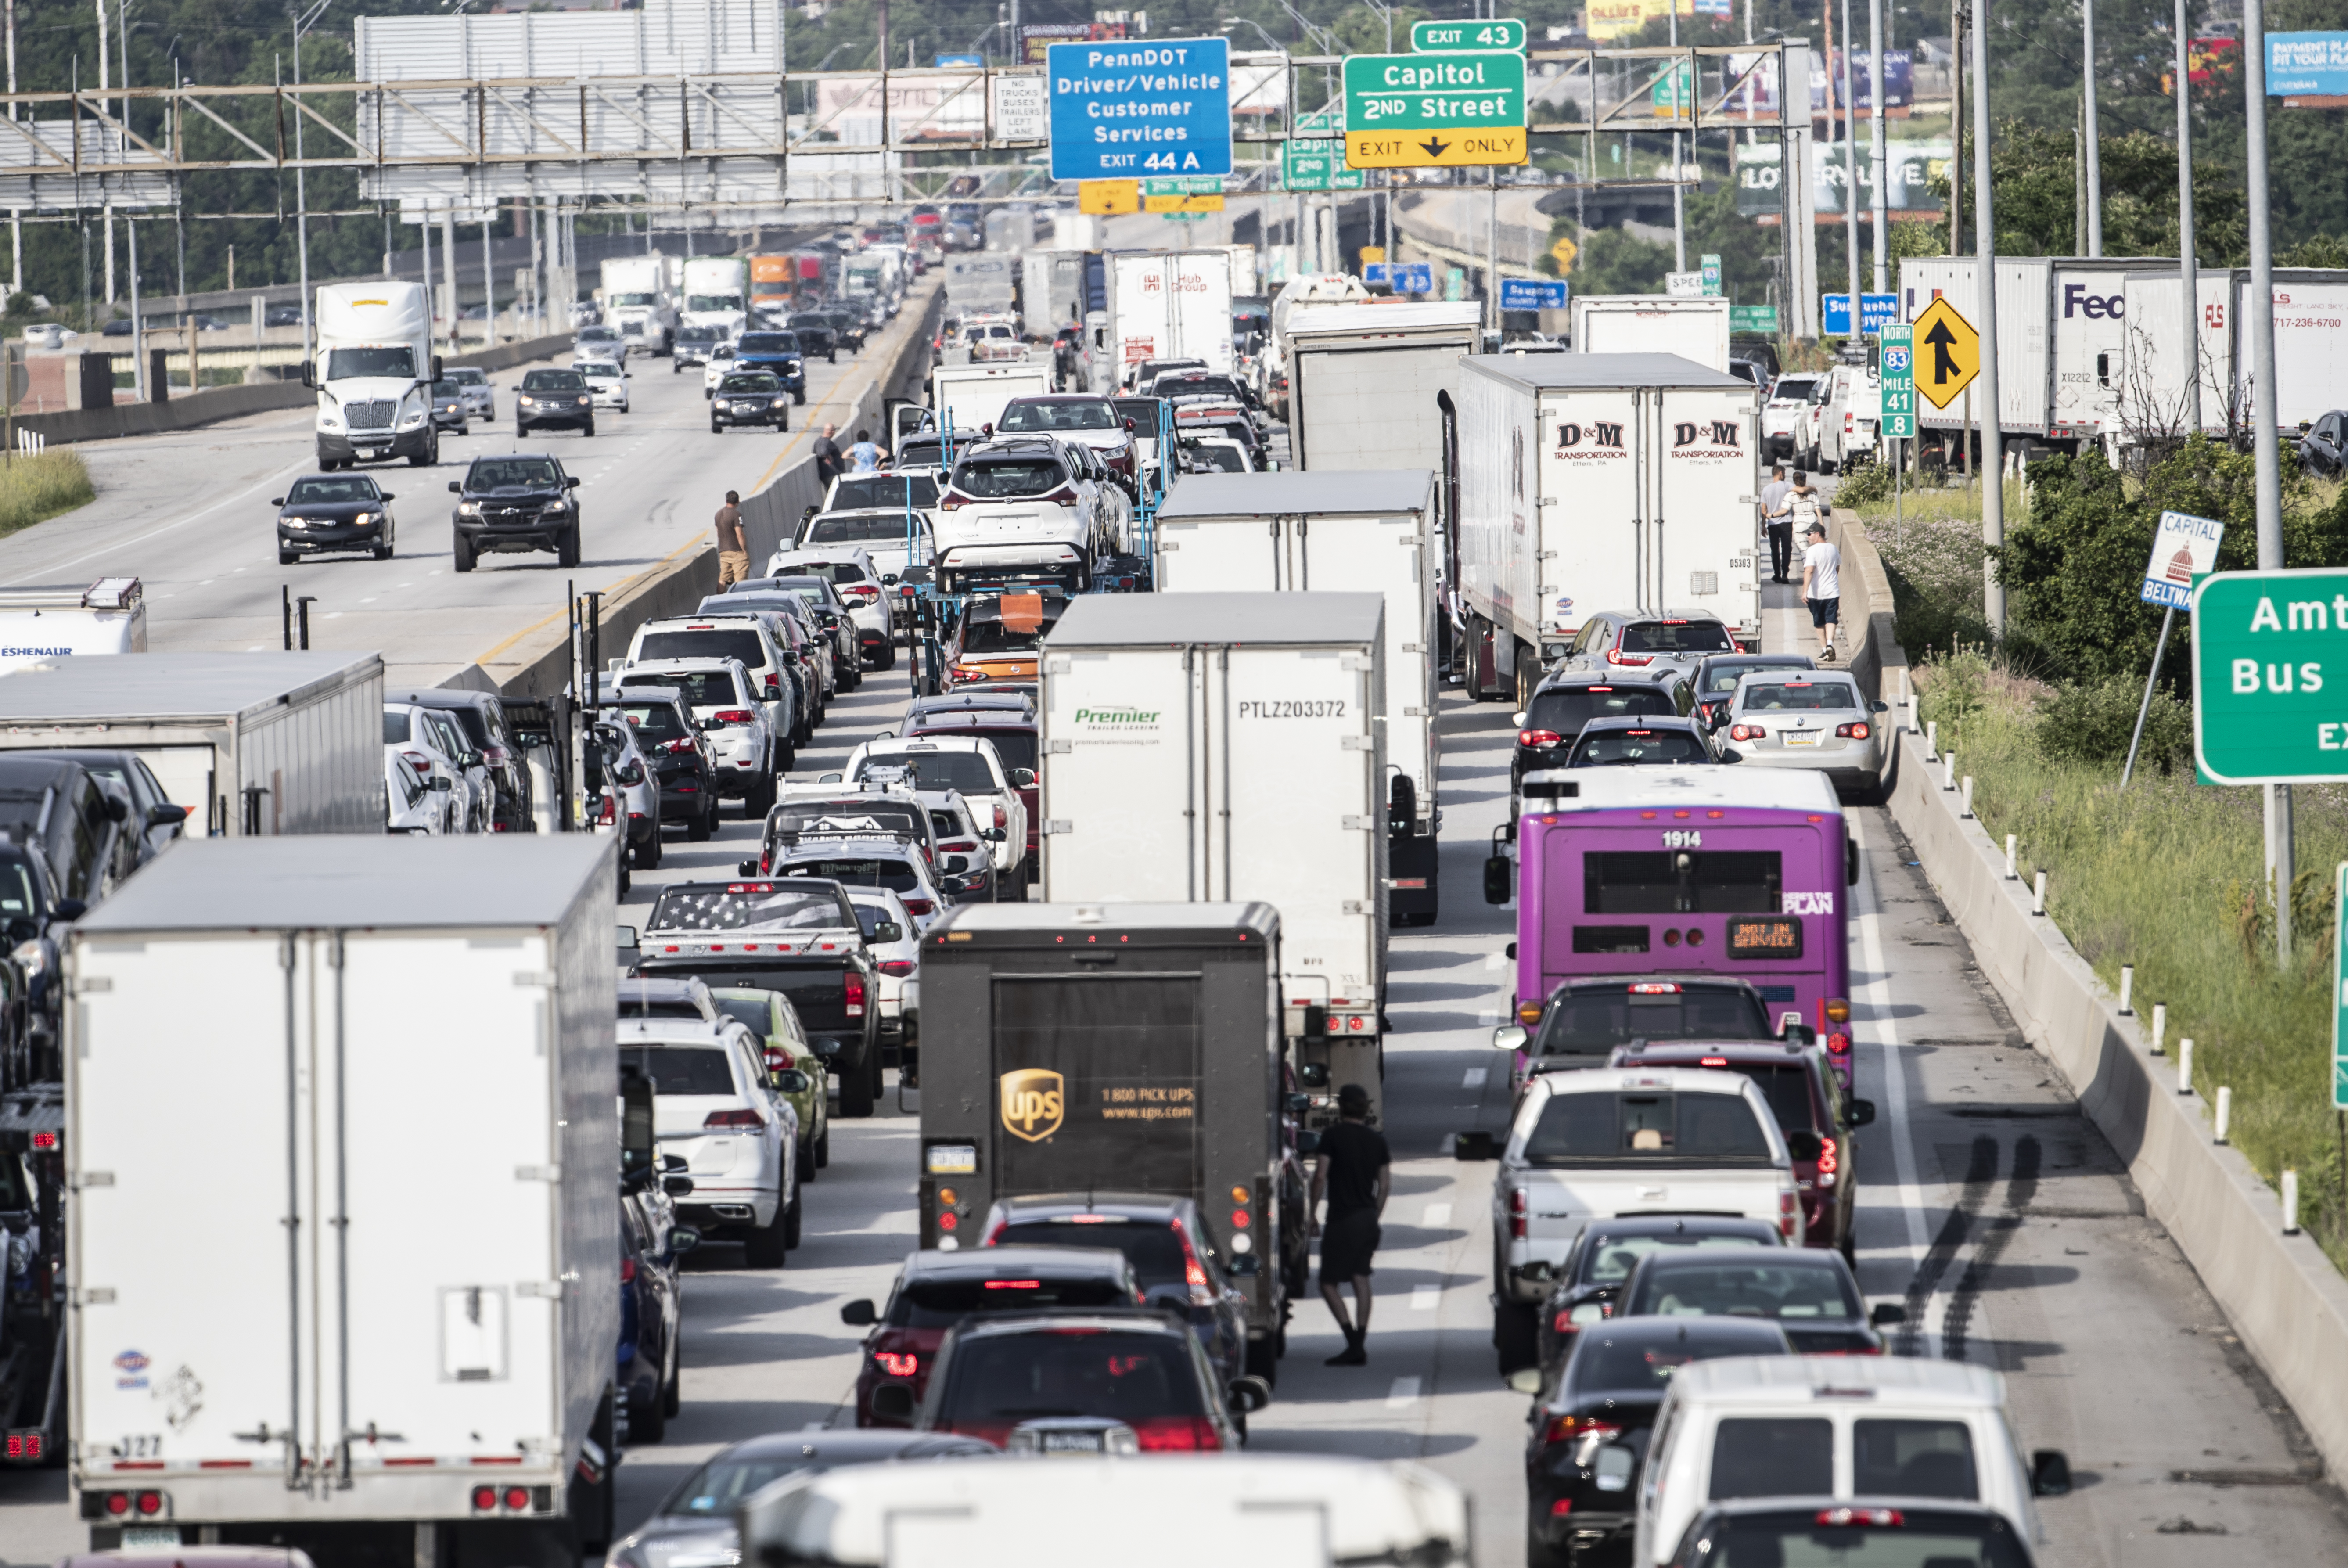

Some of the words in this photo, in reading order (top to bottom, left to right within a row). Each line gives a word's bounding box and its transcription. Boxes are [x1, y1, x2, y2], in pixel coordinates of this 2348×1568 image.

[1427, 30, 1462, 43] EXIT
[1476, 26, 1510, 45] 43
[1089, 49, 1187, 68] PennDOT
[1057, 73, 1221, 94] Driver/Vehicle
[1384, 62, 1485, 89] Capitol
[1087, 101, 1192, 118] Customer
[1364, 99, 1406, 119] 2ND
[1421, 96, 1507, 118] Street
[1094, 126, 1187, 143] Services
[1360, 141, 1402, 155] EXIT
[1464, 138, 1515, 152] ONLY
[1100, 154, 1136, 168] EXIT
[1144, 152, 1176, 170] 44
[1183, 152, 1201, 169] A
[1179, 273, 1201, 284] Hub
[1171, 283, 1208, 292] Group
[1862, 314, 1896, 326] IVER
[1884, 326, 1910, 340] NORTH
[1888, 352, 1906, 367] 83
[1884, 378, 1911, 391] MILE
[2062, 373, 2091, 383] X12212
[1888, 393, 1908, 410] 41
[1889, 416, 1906, 434] .8
[1557, 421, 1624, 450] D&M
[1674, 420, 1740, 448] D&M
[2165, 515, 2217, 541] CAPITAL
[1730, 558, 1751, 568] D5303
[2, 647, 72, 656] ESHENAUR
[2233, 659, 2323, 694] Bus
[1075, 709, 1161, 723] Premier
[1239, 701, 1345, 719] PTLZ203372
[1663, 831, 1701, 847] 1914
[1815, 892, 1833, 900] THE
[1783, 899, 1833, 915] PLAN
[1102, 1088, 1109, 1101] 1
[1111, 1088, 1136, 1102] 800
[1139, 1087, 1165, 1101] PICK
[1169, 1087, 1195, 1101] UPS
[1008, 1090, 1060, 1131] ups
[1102, 1106, 1193, 1122] www.ups.com
